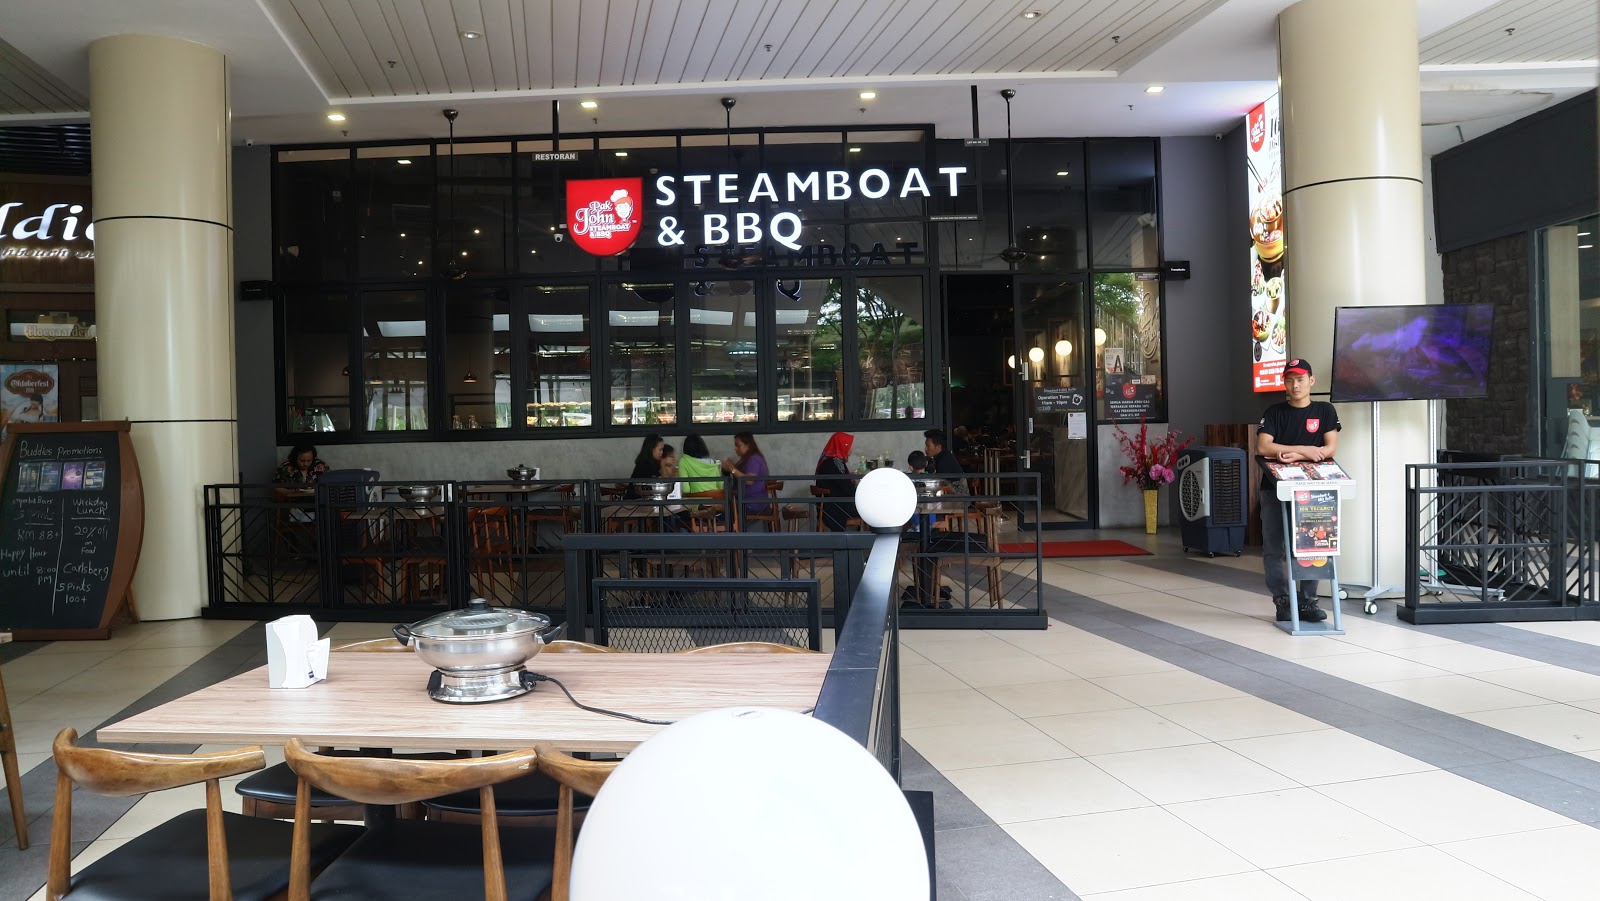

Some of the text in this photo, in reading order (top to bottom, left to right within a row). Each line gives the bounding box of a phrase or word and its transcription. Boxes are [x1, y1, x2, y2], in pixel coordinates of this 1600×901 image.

[535, 153, 576, 161] RESTORAN
[655, 166, 968, 207] STEAMBOAT
[589, 200, 614, 213] Pak
[574, 207, 616, 236] John
[590, 223, 630, 231] STEAMBOAT
[656, 211, 803, 251] & BBQ
[27, 324, 93, 339] Hoegaarden
[1114, 354, 1123, 372] A
[10, 379, 49, 388] Oktoberfest
[19, 440, 53, 458] Buddies
[74, 525, 97, 539] 20%
[0, 546, 47, 562] Happy Hour
[81, 546, 97, 555] Food
[3, 563, 57, 577] until 8:00
[63, 561, 109, 581] Carlsberg
[55, 582, 65, 592] 5
[65, 594, 87, 604] 100+
